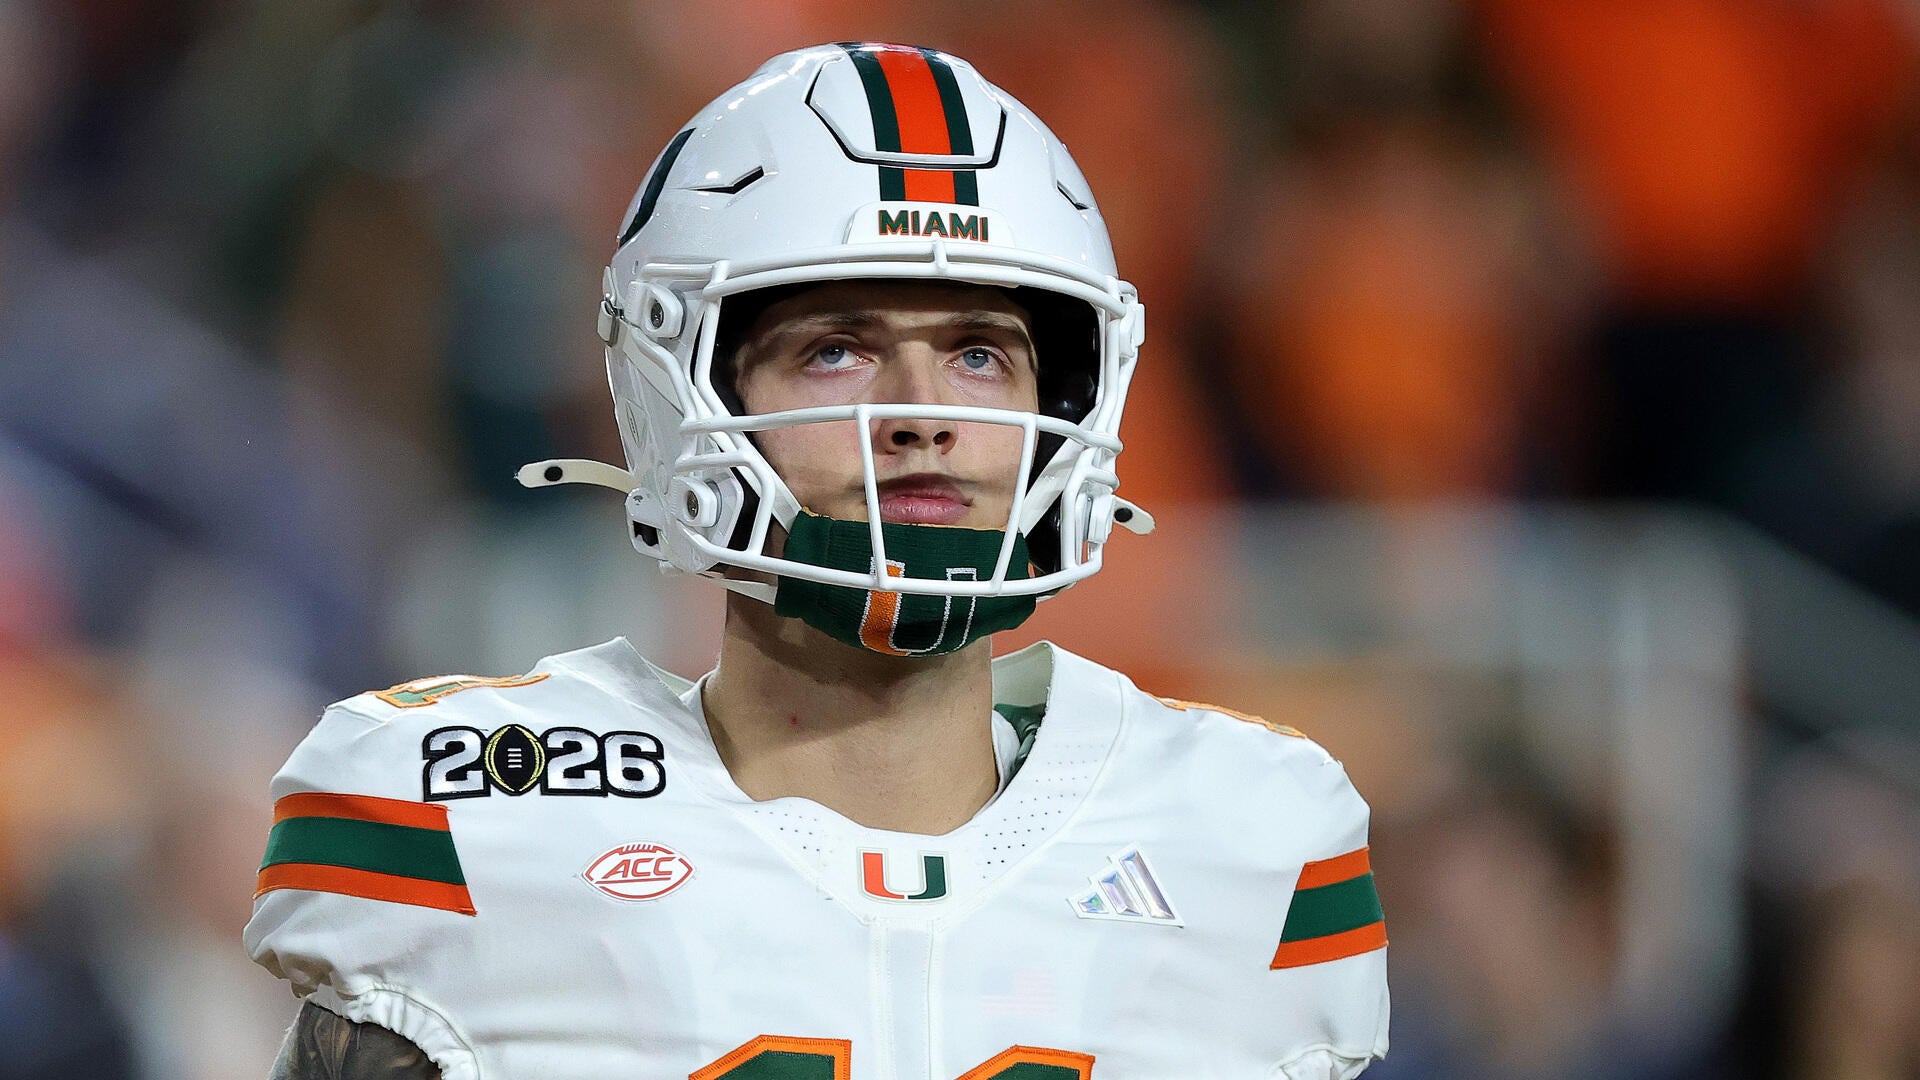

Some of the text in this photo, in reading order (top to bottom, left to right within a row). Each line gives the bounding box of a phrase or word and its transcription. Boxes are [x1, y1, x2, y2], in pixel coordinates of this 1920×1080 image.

[878, 209, 989, 242] MIAMI
[858, 556, 977, 658] U
[422, 723, 667, 803] 2026
[601, 856, 677, 879] ACC
[861, 851, 948, 901] U
